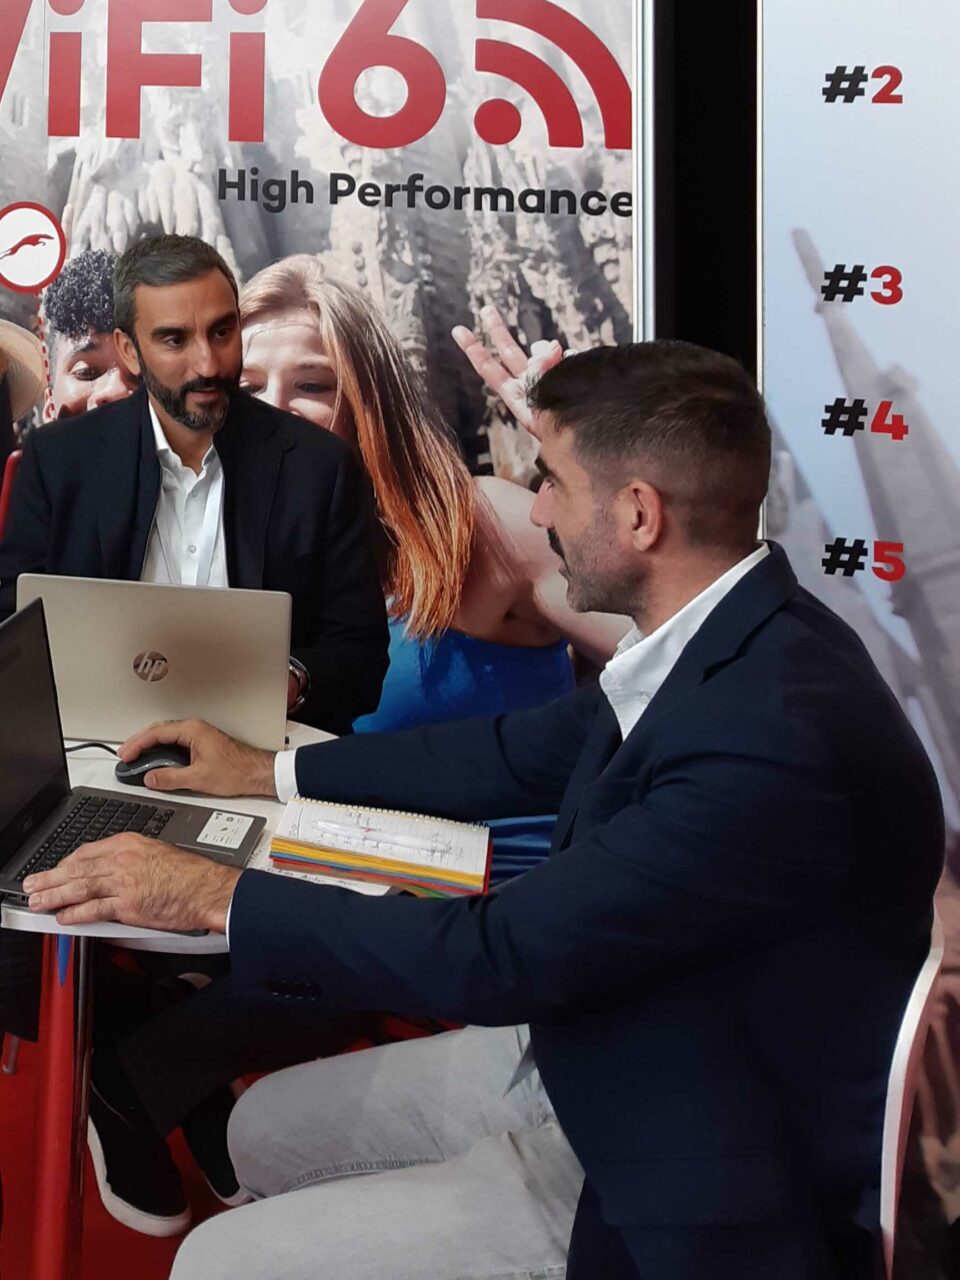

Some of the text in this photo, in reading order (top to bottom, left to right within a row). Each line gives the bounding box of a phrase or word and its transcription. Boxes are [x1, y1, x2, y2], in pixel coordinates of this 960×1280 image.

[822, 66, 903, 104] #2
[218, 169, 632, 217] High Performance
[821, 264, 903, 305] #3
[821, 398, 909, 441] #4
[821, 537, 906, 582] #5
[137, 652, 166, 681] hp
